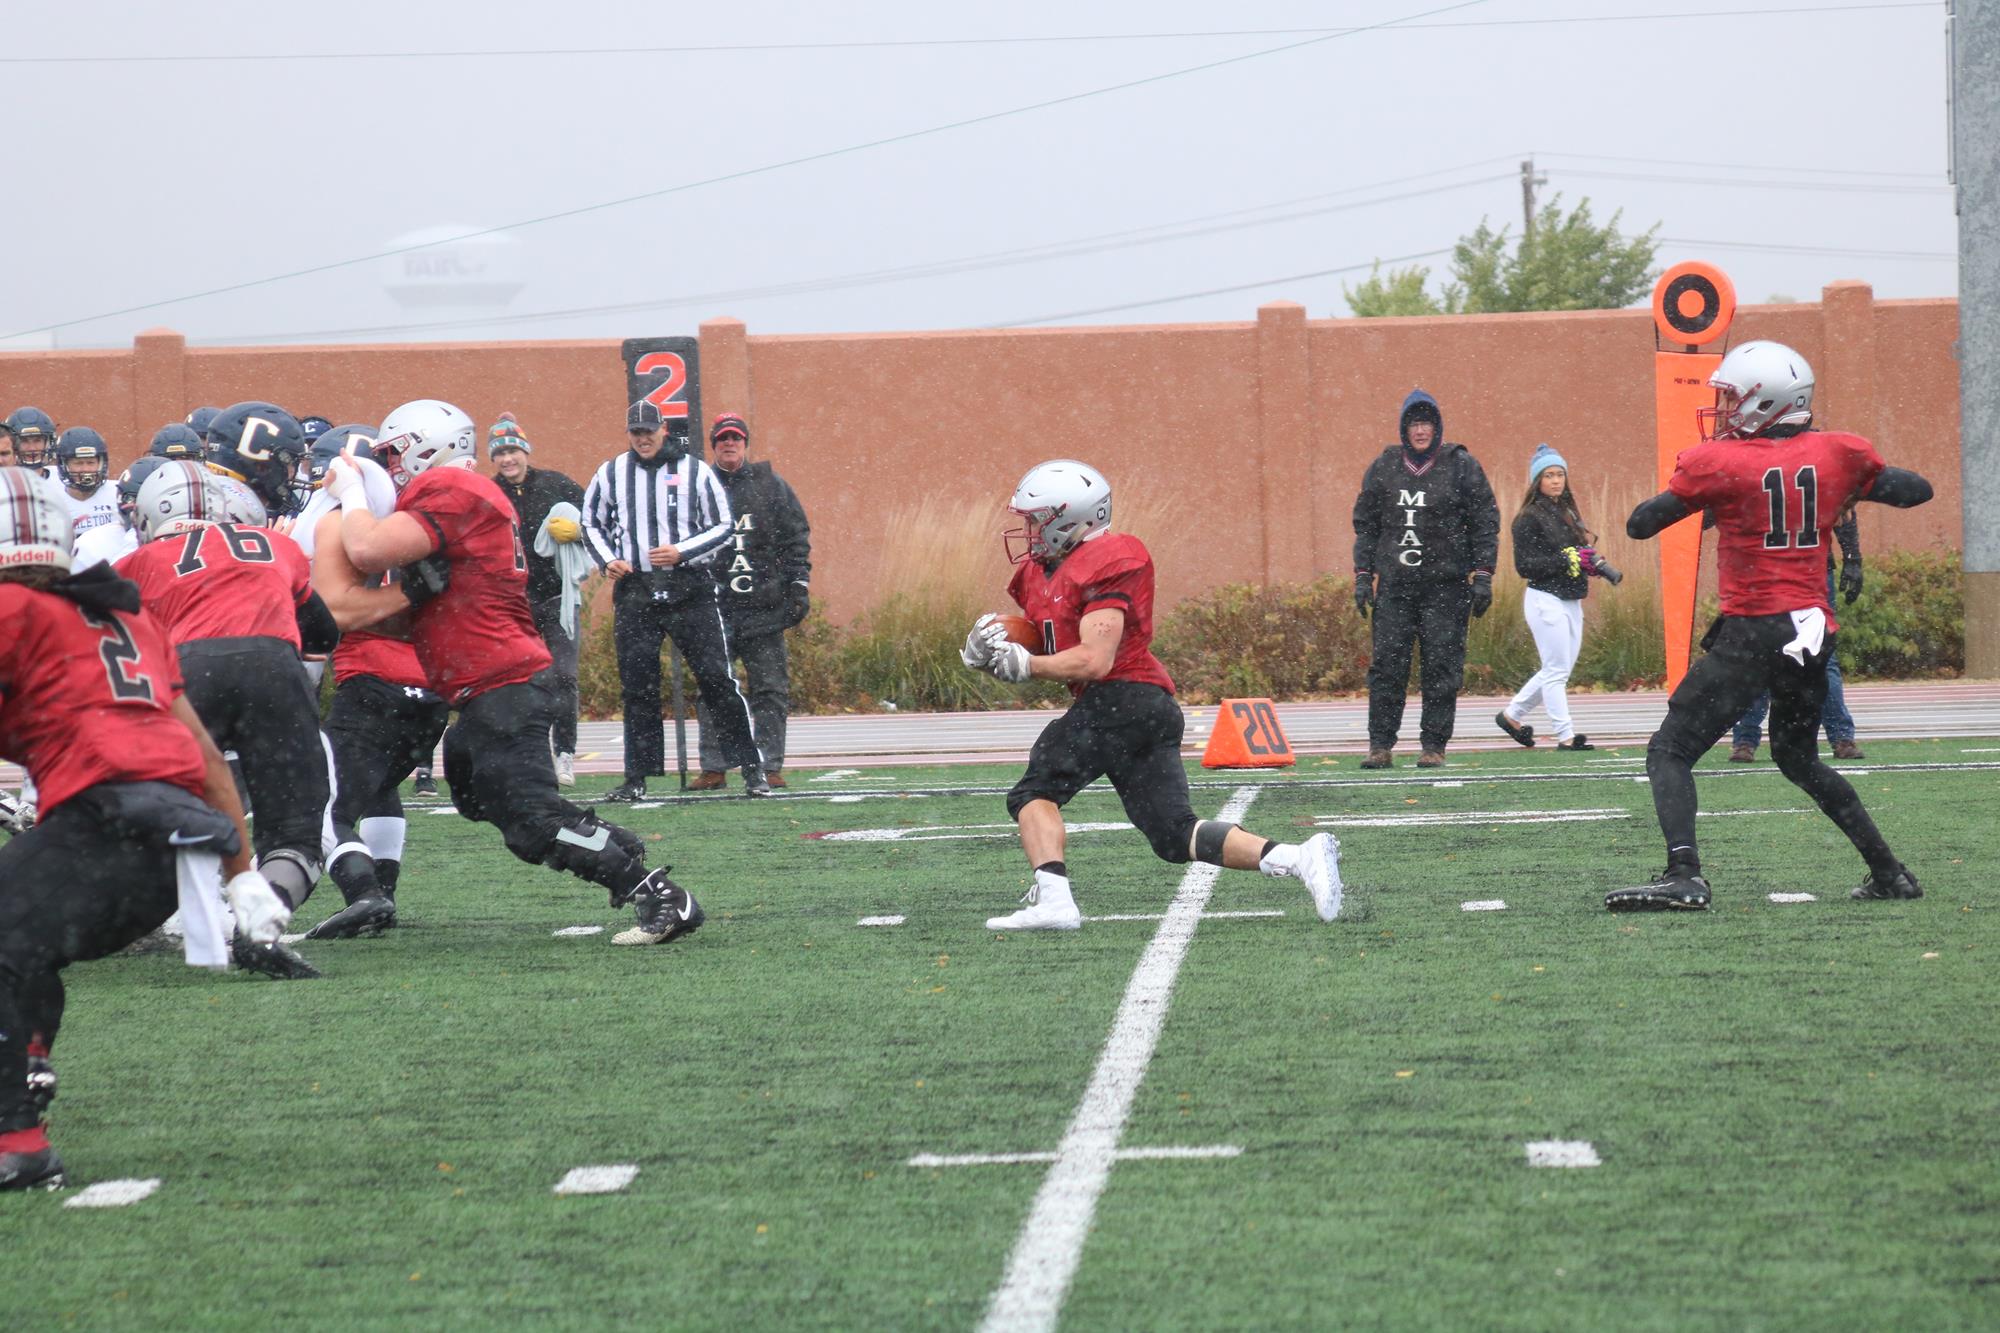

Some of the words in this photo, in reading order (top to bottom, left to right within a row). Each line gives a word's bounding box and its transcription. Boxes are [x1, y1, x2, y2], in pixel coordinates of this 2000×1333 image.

[635, 352, 688, 418] 2
[237, 416, 280, 461] C
[668, 494, 677, 506] L
[1397, 489, 1427, 567] MIAC
[1762, 465, 1820, 549] 11
[160, 522, 275, 577] 76
[728, 513, 754, 593] MIAC
[79, 606, 158, 705] 2
[1231, 703, 1289, 755] 20
